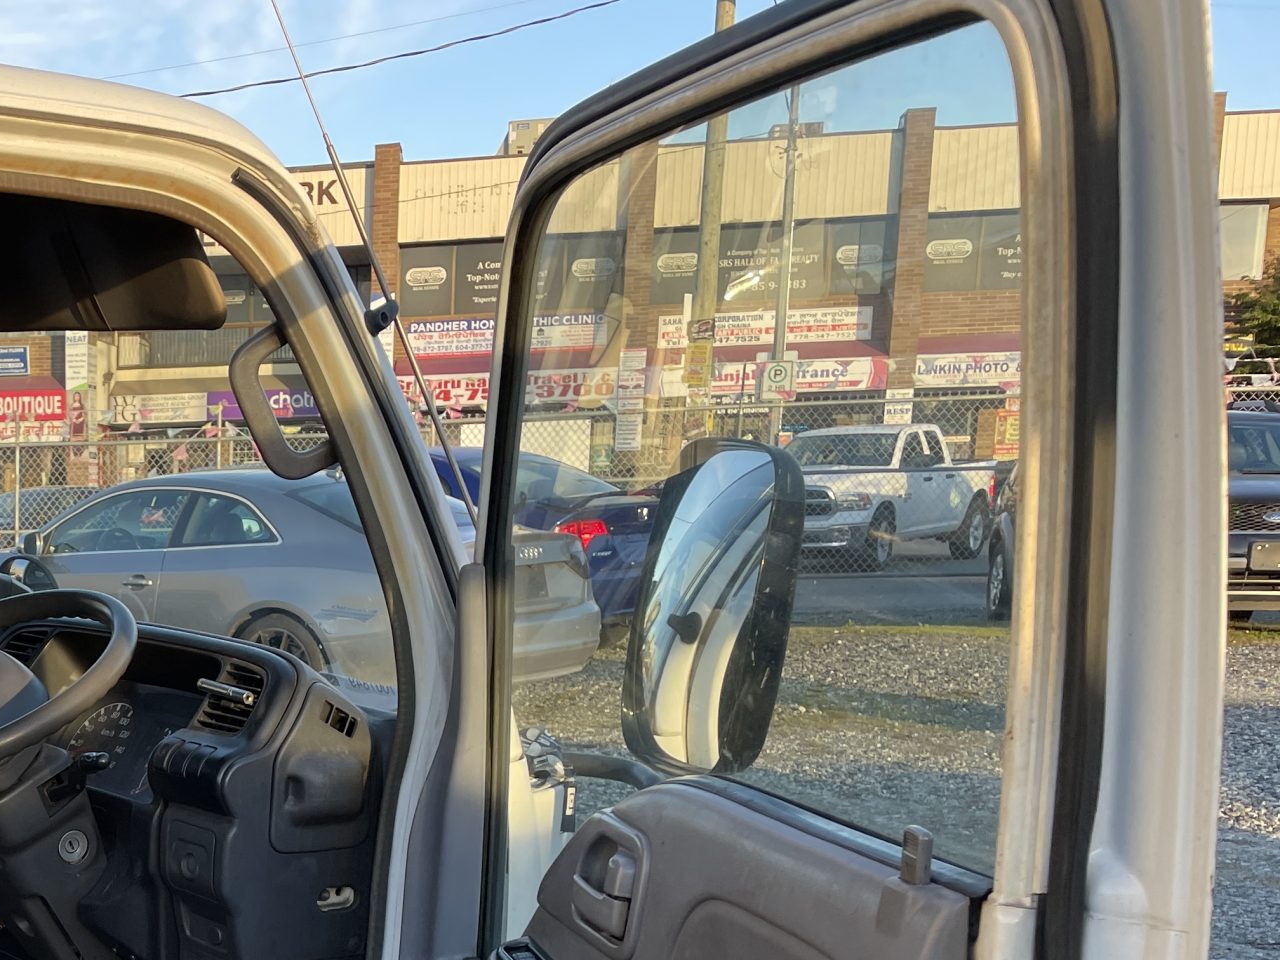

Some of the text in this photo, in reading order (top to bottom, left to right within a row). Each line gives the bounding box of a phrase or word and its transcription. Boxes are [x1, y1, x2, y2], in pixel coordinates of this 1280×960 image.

[563, 314, 605, 325] CLINIC
[411, 322, 468, 333] PANDHER
[966, 362, 1010, 374] PHOTO
[774, 369, 783, 379] P
[886, 407, 912, 416] RESP
